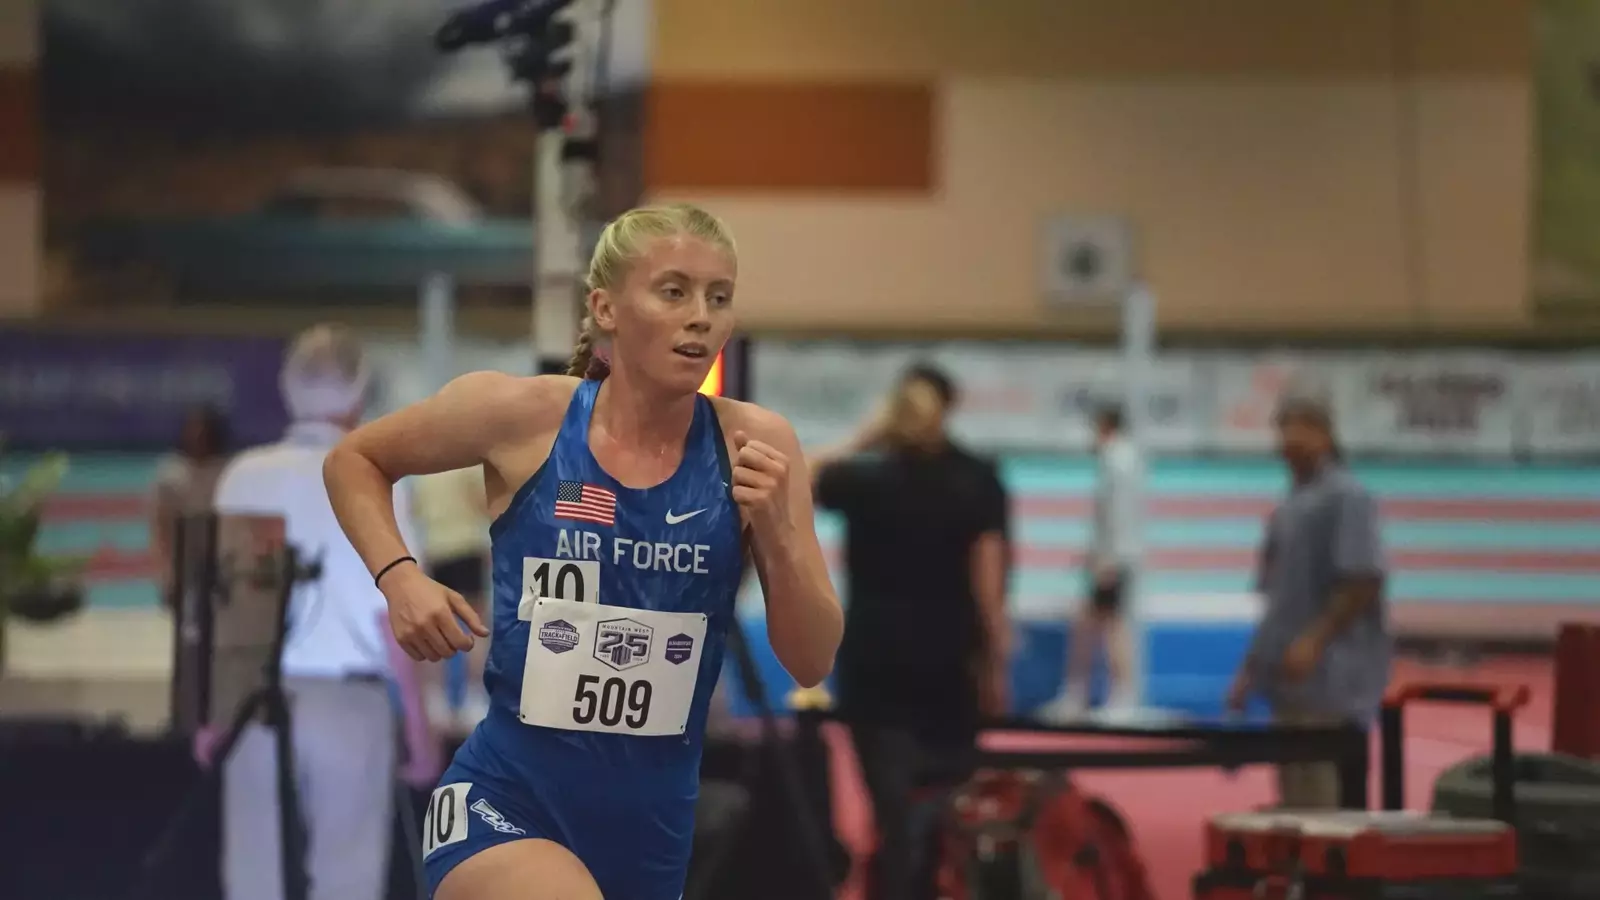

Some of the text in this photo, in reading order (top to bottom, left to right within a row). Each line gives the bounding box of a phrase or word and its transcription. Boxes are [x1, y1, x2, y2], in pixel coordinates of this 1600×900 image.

[556, 528, 711, 574] AIR FORCE
[533, 562, 585, 602] 10
[598, 630, 649, 656] 25
[602, 623, 632, 632] MOUNTAIN
[572, 674, 653, 729] 509
[427, 787, 455, 850] 10
